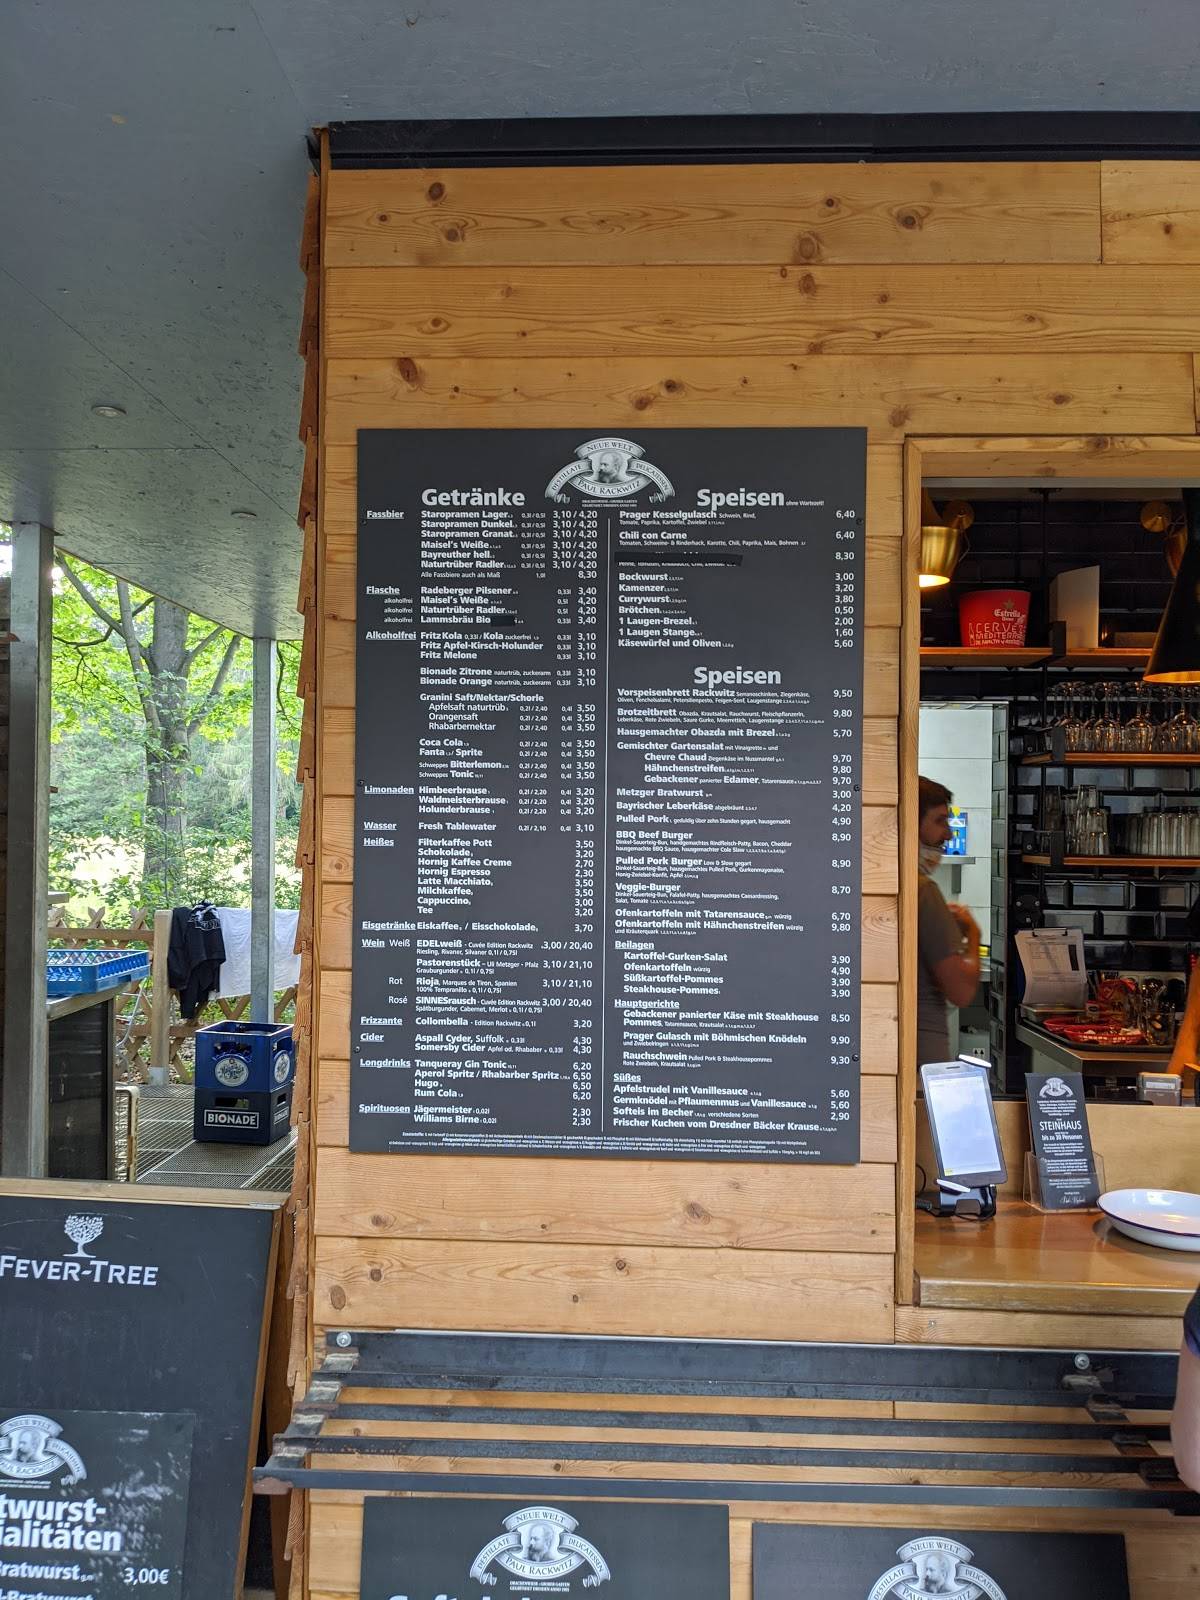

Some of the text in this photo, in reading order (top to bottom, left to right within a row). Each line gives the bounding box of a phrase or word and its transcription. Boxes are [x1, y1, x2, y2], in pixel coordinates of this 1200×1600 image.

[587, 442, 633, 452] NEUE WELT
[577, 480, 641, 495] PAUL RACKWITZ
[422, 488, 525, 506] Getränke
[696, 488, 785, 512] Speisen
[367, 510, 479, 520] Fassbier Staropramen
[620, 511, 650, 520] Prager
[652, 510, 717, 520] Kesselgulasch
[836, 510, 855, 519] 6,40
[619, 531, 639, 539] Chili
[421, 550, 471, 560] Bayreuther
[421, 560, 473, 568] Naturtrüber
[835, 573, 854, 581] 3,00
[366, 586, 597, 596] Flasche Radeberger 3,40
[460, 596, 489, 604] Weiße
[366, 631, 416, 640] Alkoholfrei
[578, 633, 596, 641] 3,10
[627, 628, 853, 637] Laugen 1,60
[421, 641, 543, 651] Fritz Apfel-Kirsch-Holunder
[444, 651, 477, 659] Melone
[420, 667, 457, 675] Bionade
[459, 667, 492, 675] Zitrone
[694, 666, 781, 688] Speisen
[459, 678, 492, 687] Orange
[420, 693, 544, 701] Granini Saft/Nektar/Schorle
[618, 688, 690, 698] Vorspeisenbrett
[833, 689, 852, 698] 9,50
[429, 703, 595, 712] Apfelsaft naturtrüb 3,50
[618, 708, 676, 716] Brotzeitbrett
[429, 713, 478, 722] Orangensaft
[429, 722, 496, 730] Rhabarbernektar
[617, 728, 852, 738] Hausgemachter Obazda 5,70
[671, 742, 724, 750] Gartensalat
[678, 753, 707, 761] Chaud
[644, 775, 698, 783] Gebackener
[365, 785, 414, 794] Limonaden
[617, 788, 655, 798] Metzger
[617, 801, 713, 811] Bayrischer Leberkäse
[364, 822, 496, 830] Wasser Fresh Tablewater
[616, 831, 636, 839] BBQ
[662, 831, 693, 840] Burger
[363, 838, 394, 846] Heißes
[418, 838, 471, 846] Filterkaffee
[418, 858, 448, 867] Hornig
[451, 858, 481, 866] Kaffee
[575, 860, 593, 868] 2,70
[671, 857, 702, 867] Burger
[451, 868, 593, 878] Espresso 2,30
[616, 883, 850, 894] Veggie-Burger 8,70
[615, 909, 683, 917] Ofenkartoffeln
[362, 921, 416, 931] Eisgetränke
[704, 921, 784, 930] Hähnchenstreifen
[362, 939, 385, 947] Wein
[389, 939, 410, 947] Weiß
[615, 940, 654, 950] Beilagen
[417, 959, 480, 967] Pastorenstück
[624, 952, 850, 964] Kartoffel-Gurken-Salat 3,90
[624, 974, 723, 983] Süßkartoffel-Pommes
[389, 996, 476, 1004] Rosé SINNESrausch
[615, 999, 680, 1009] Hauptgerichte
[360, 1016, 468, 1025] Frizzante Collombella
[724, 1011, 818, 1021] Käse Steakhouse
[360, 1033, 592, 1045] Cider Aspall Cyder, Suffolk 4,30
[656, 1032, 806, 1043] Gulasch Böhmischen Knödeln
[415, 1043, 459, 1053] Somersby
[623, 1051, 687, 1060] Rauchschwein
[360, 1059, 411, 1068] Longdrinks
[573, 1072, 591, 1081] 6,50
[614, 1073, 641, 1083] Süßes
[613, 1084, 748, 1095] Apfelstrudel Vanillesauce
[751, 1099, 806, 1108] Vanillesauce
[359, 1104, 472, 1115] Spirituosen Jägermeister
[613, 1107, 693, 1116] Softeis Becher
[207, 1113, 256, 1125] BIONADE
[455, 1115, 479, 1123] Birne
[613, 1118, 785, 1130] Frischer Kuchen Dresdner Bäcker
[1039, 1120, 1082, 1131] STEINHAUS
[0, 1255, 159, 1286] FEVER-TREE
[516, 1511, 566, 1524] NEUE WELT
[910, 1542, 961, 1554] NEUE WELT
[505, 1557, 574, 1576] PAUL RACKWITZ
[122, 1568, 170, 1585] 3,00€
